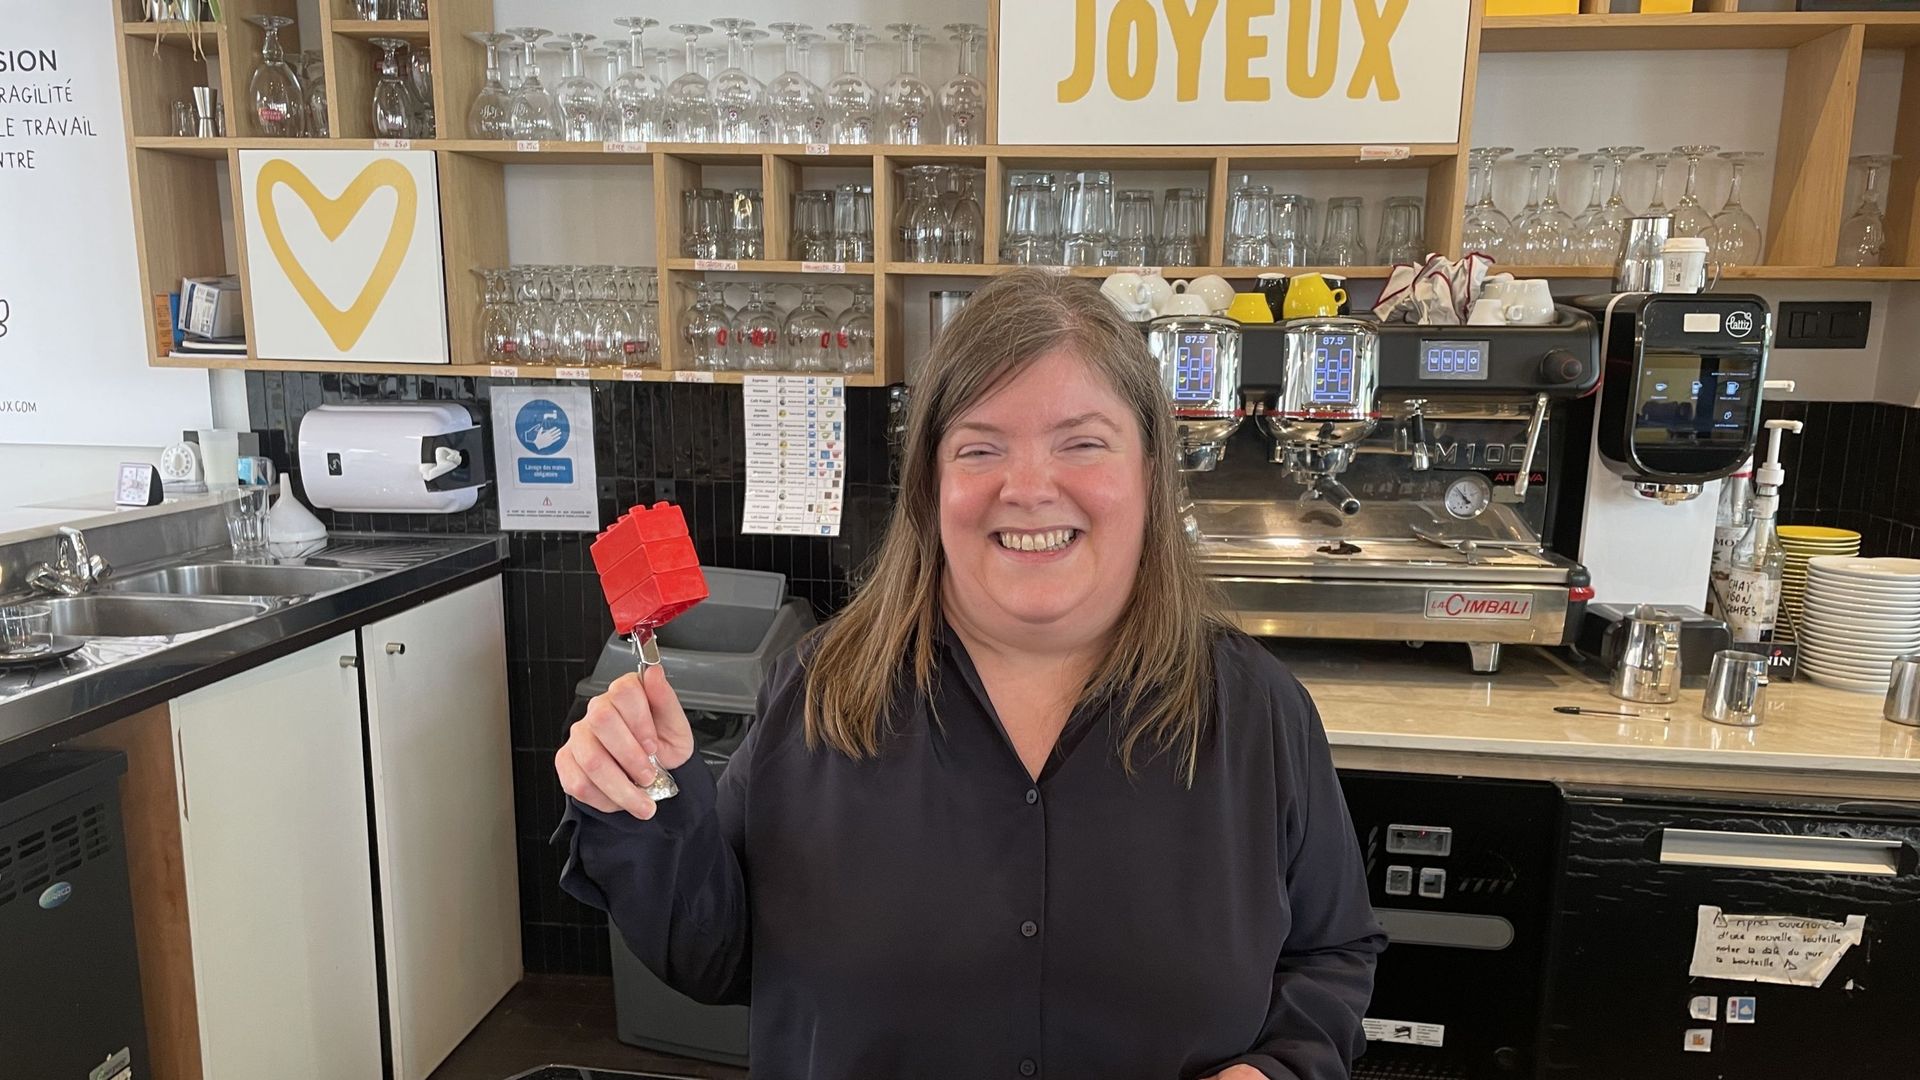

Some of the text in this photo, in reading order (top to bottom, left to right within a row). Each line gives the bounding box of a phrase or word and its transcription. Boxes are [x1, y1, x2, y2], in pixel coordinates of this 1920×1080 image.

[1057, 0, 1412, 103] JOYEUX
[0, 149, 35, 169] TRE
[1494, 472, 1544, 482] ATTVA
[1446, 593, 1528, 616] CIMBALI
